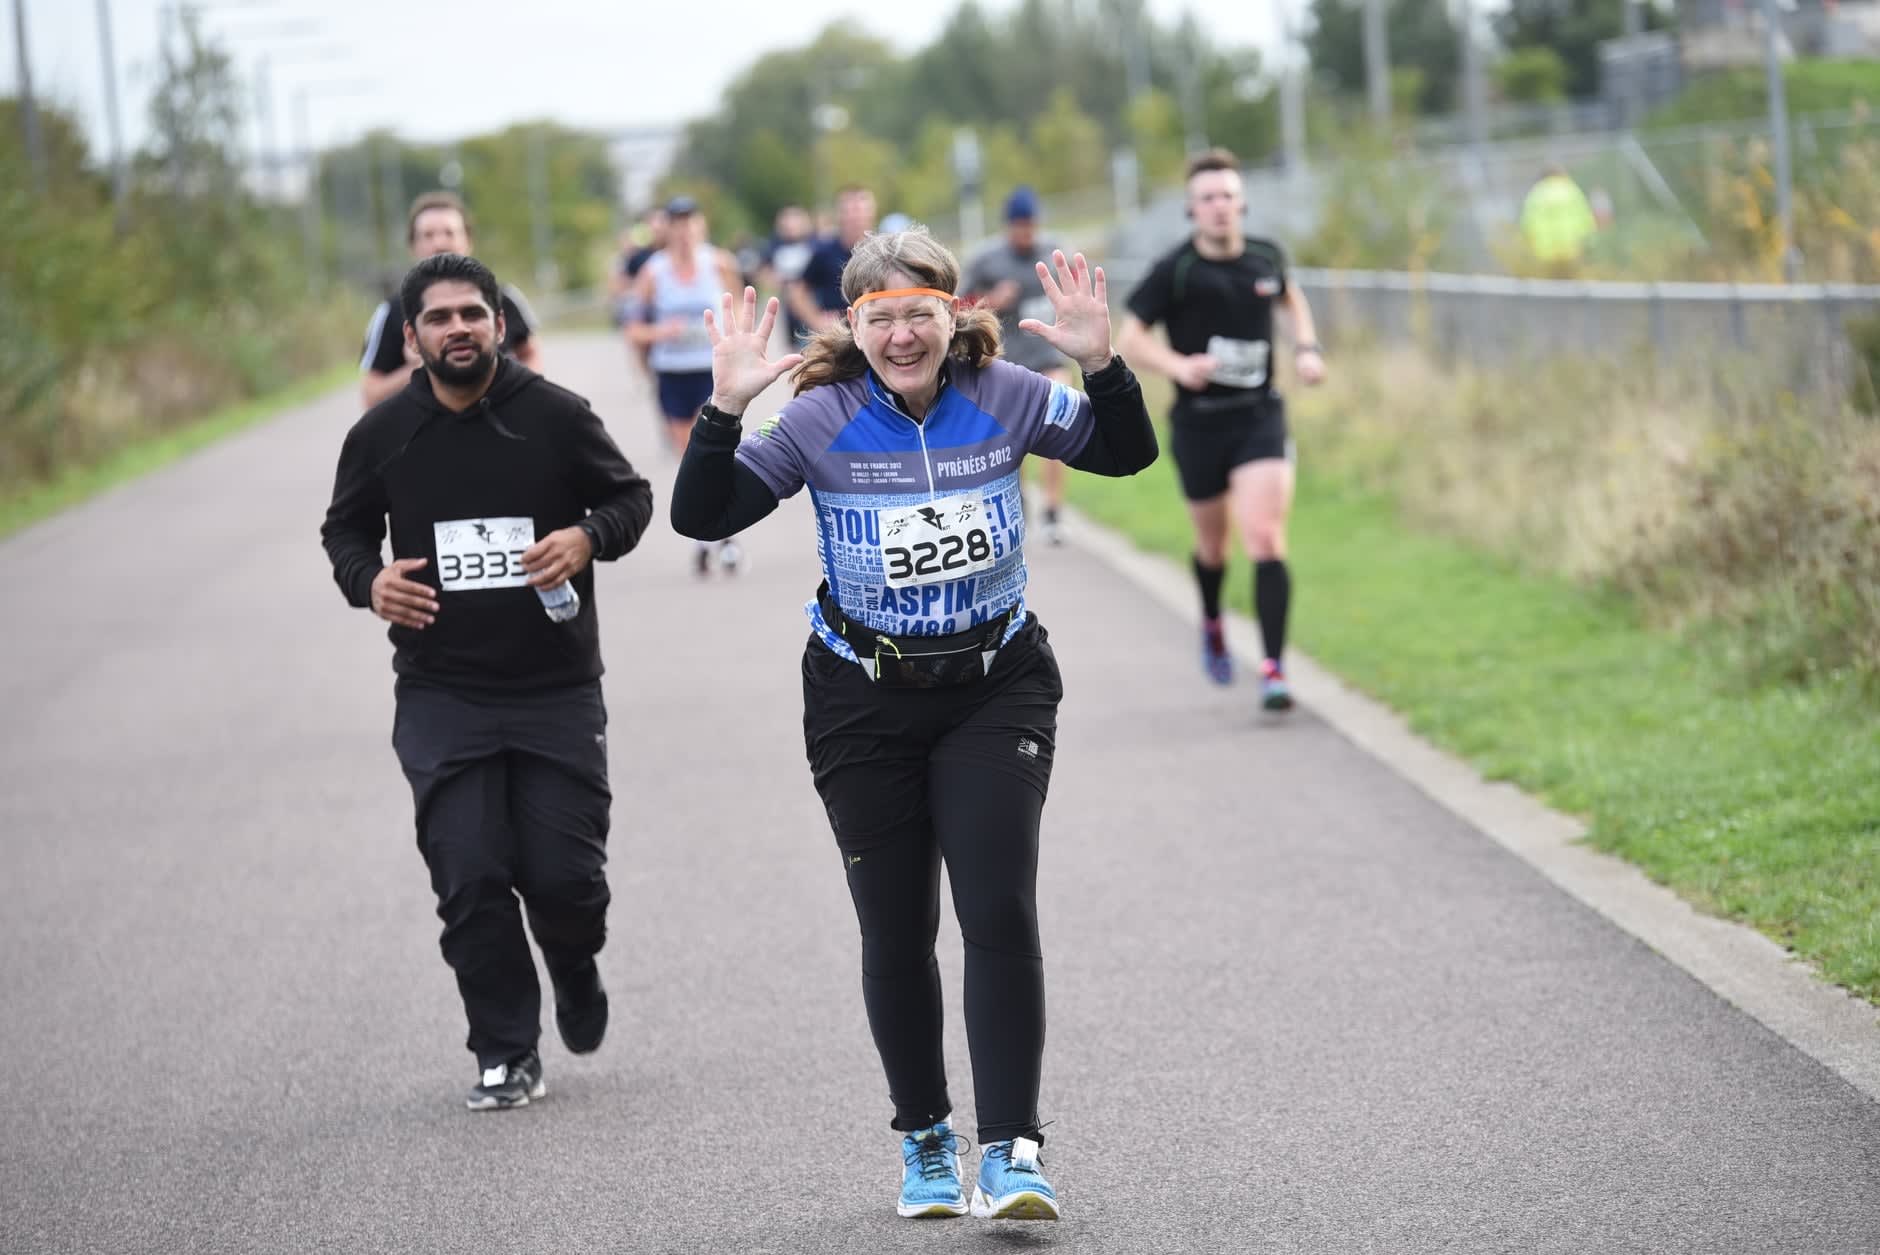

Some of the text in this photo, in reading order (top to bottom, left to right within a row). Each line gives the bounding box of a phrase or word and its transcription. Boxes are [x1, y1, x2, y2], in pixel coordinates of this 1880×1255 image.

[937, 445, 1012, 477] PYRÉNÉES 2012
[884, 528, 990, 580] 3228
[881, 578, 976, 616] ASPIN
[970, 604, 988, 628] M
